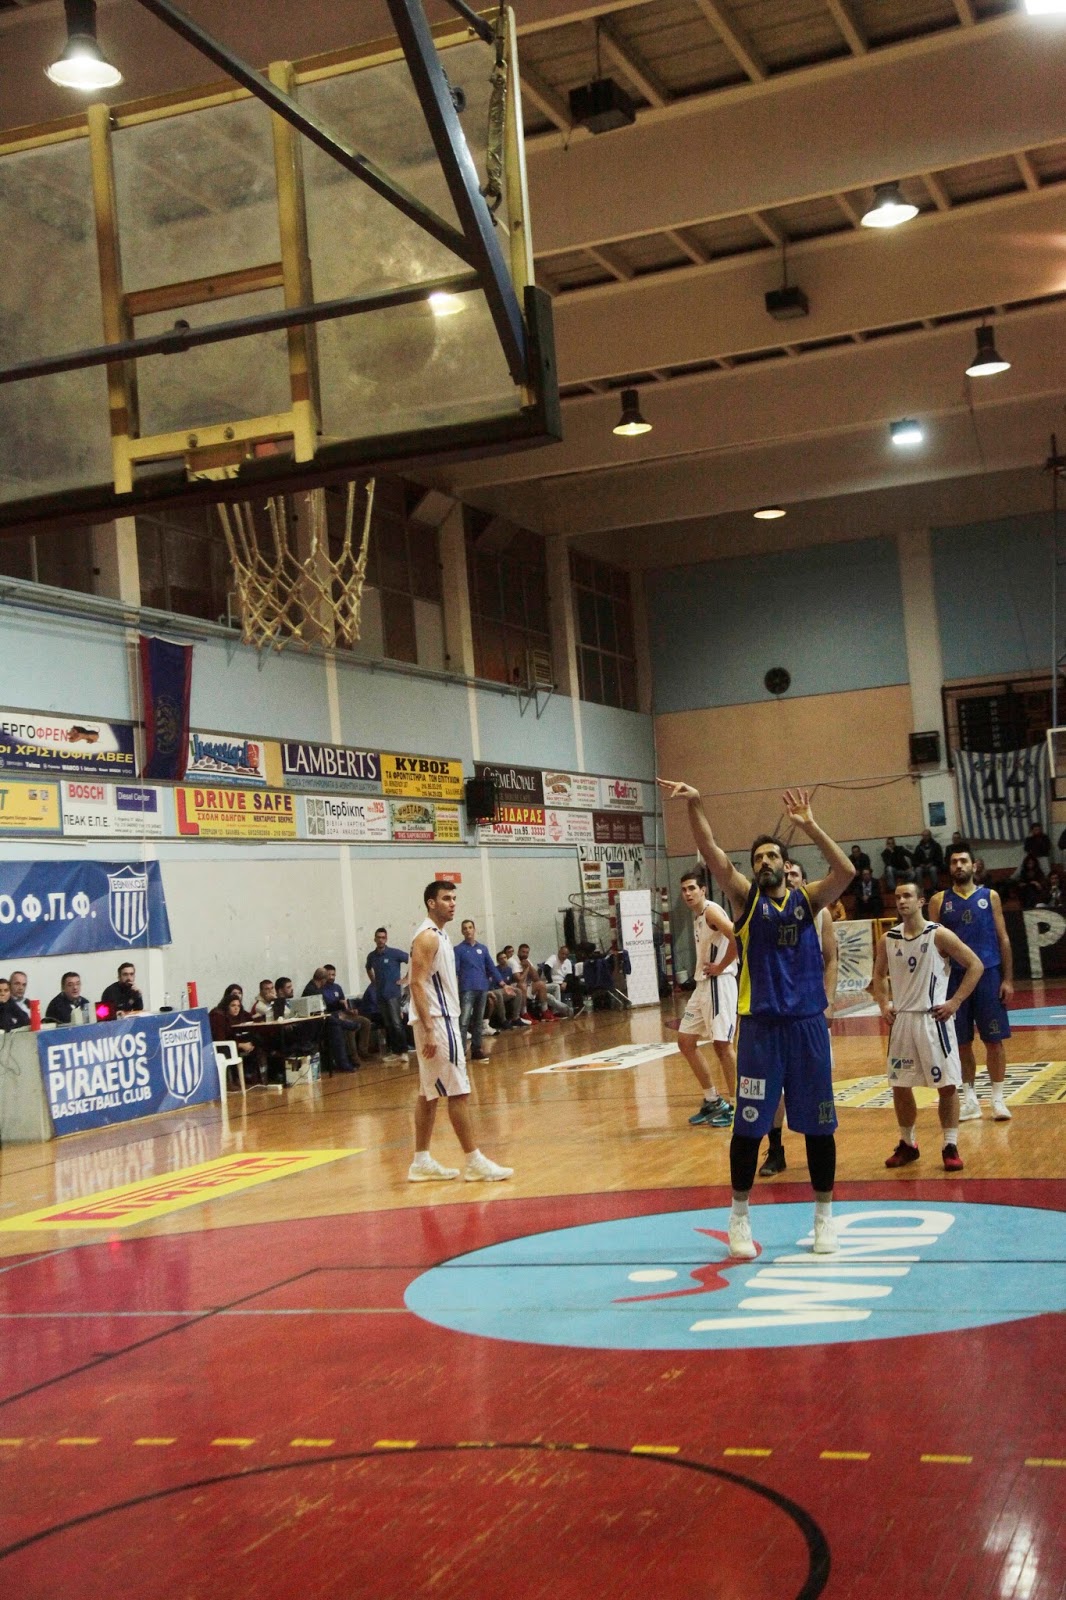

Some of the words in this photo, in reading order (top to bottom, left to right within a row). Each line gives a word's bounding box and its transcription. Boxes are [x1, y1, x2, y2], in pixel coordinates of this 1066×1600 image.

[96, 752, 134, 763] ΑΒΕΕ
[283, 743, 377, 779] LAMBERTS
[395, 757, 450, 775] ΚΥΒΟΣ
[385, 771, 392, 779] ΤΑ
[68, 783, 105, 800] BOSCH
[118, 791, 133, 801] Diesel
[194, 789, 246, 810] DRIVE
[253, 793, 293, 812] SAFE
[64, 814, 86, 827] ΠΕΑΚ
[112, 879, 146, 889] ΕΘΝΙΚΟΣ
[961, 909, 973, 924] 4
[778, 923, 798, 945] 17
[907, 956, 917, 973] 9
[163, 1028, 198, 1045] ΕΘΝΙΚΟΣ
[47, 1032, 148, 1072] ETHNIKOS
[49, 1056, 151, 1103] PIRAEUS
[931, 1066, 942, 1083] 9
[51, 1092, 122, 1120] BASKETBALL
[122, 1085, 153, 1105] CLUB
[689, 1209, 956, 1332] WIND
